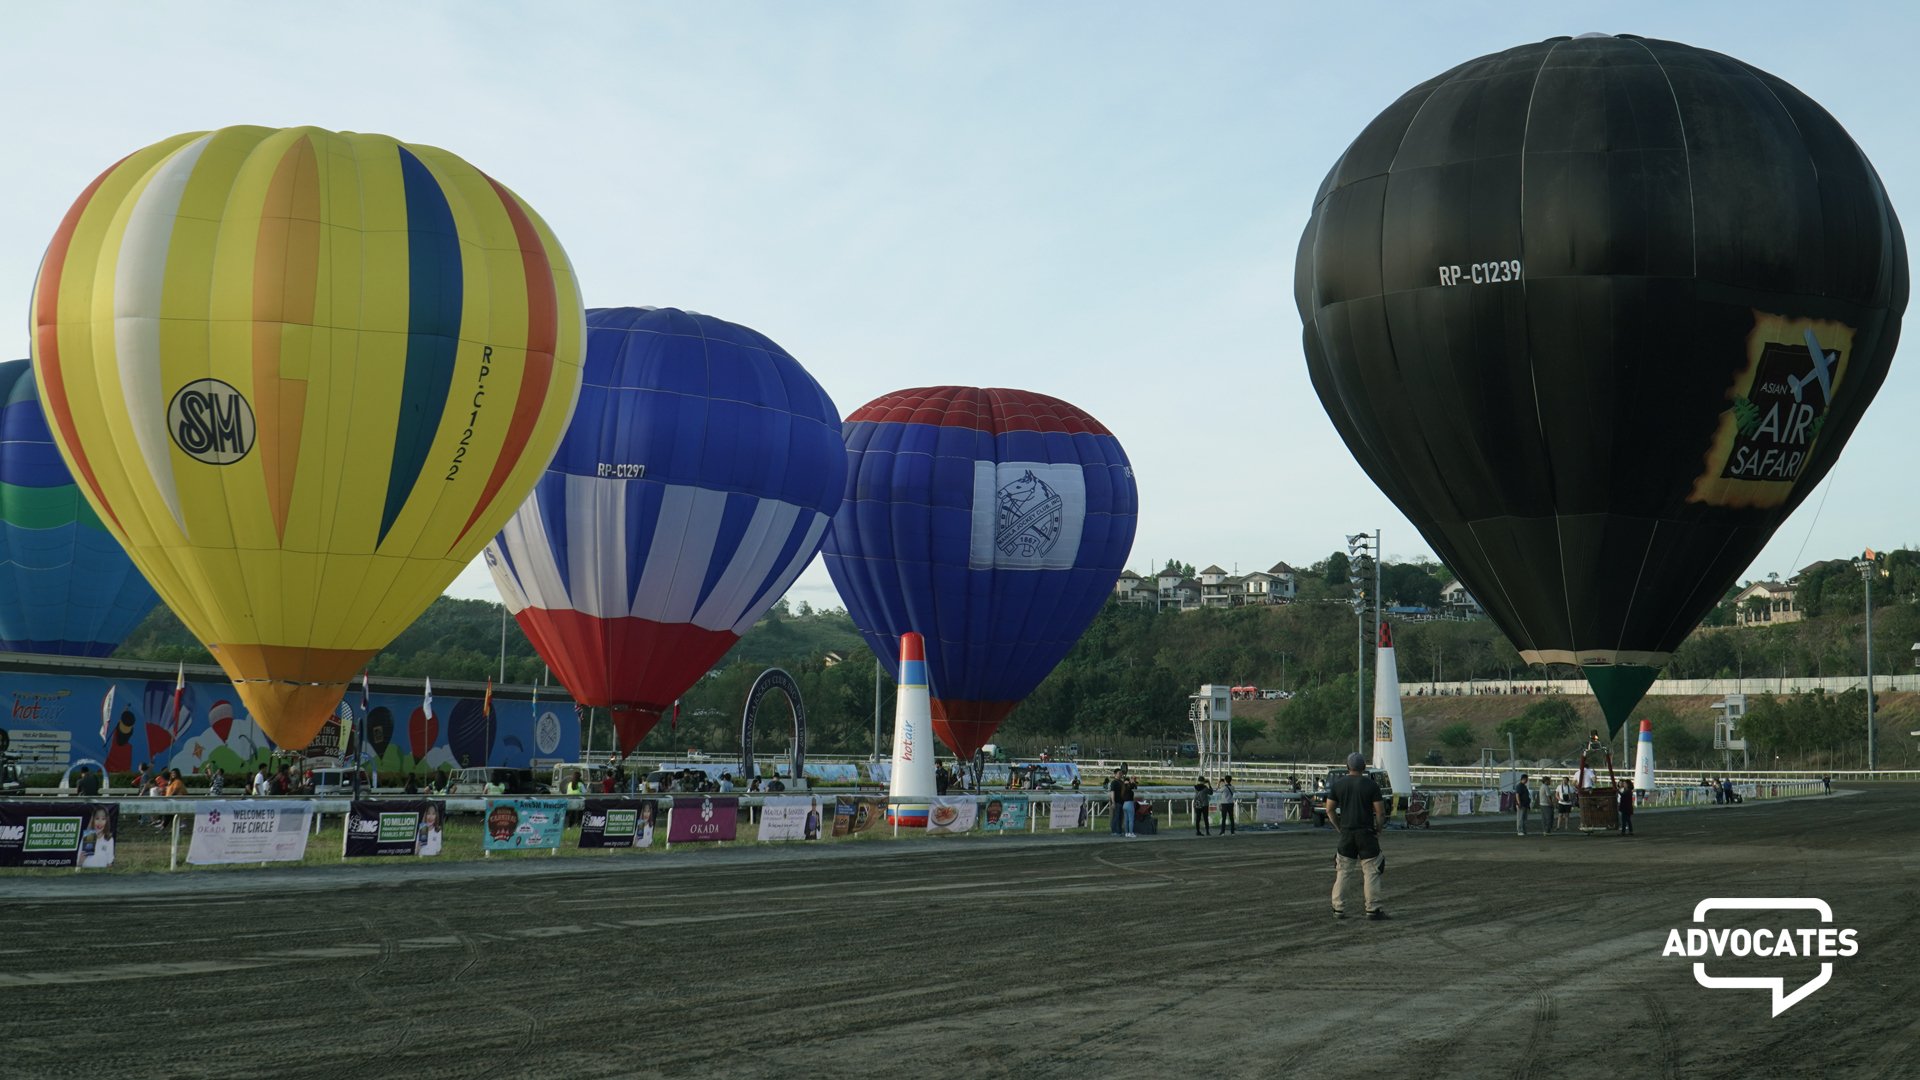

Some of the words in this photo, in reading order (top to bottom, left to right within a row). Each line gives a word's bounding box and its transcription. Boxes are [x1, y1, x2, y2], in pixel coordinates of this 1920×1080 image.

[1439, 260, 1521, 286] RP-C1239
[1760, 382, 1788, 395] ASIAN
[178, 390, 245, 454] SM
[1751, 401, 1814, 444] AIR
[1731, 445, 1806, 478] SAFARI
[597, 463, 645, 478] RP-C1297
[1016, 514, 1036, 530] JOCKEY
[745, 705, 757, 747] MANILA
[233, 808, 266, 820] WELCOME
[267, 808, 275, 819] TO
[31, 823, 41, 832] 10
[42, 822, 77, 832] MILLION
[232, 821, 247, 833] THE
[248, 821, 274, 833] CIRCLE
[357, 820, 378, 833] IMG
[383, 818, 390, 826] 10
[391, 817, 415, 826] MILLION
[588, 816, 606, 827] IMG
[690, 824, 719, 833] OKADA
